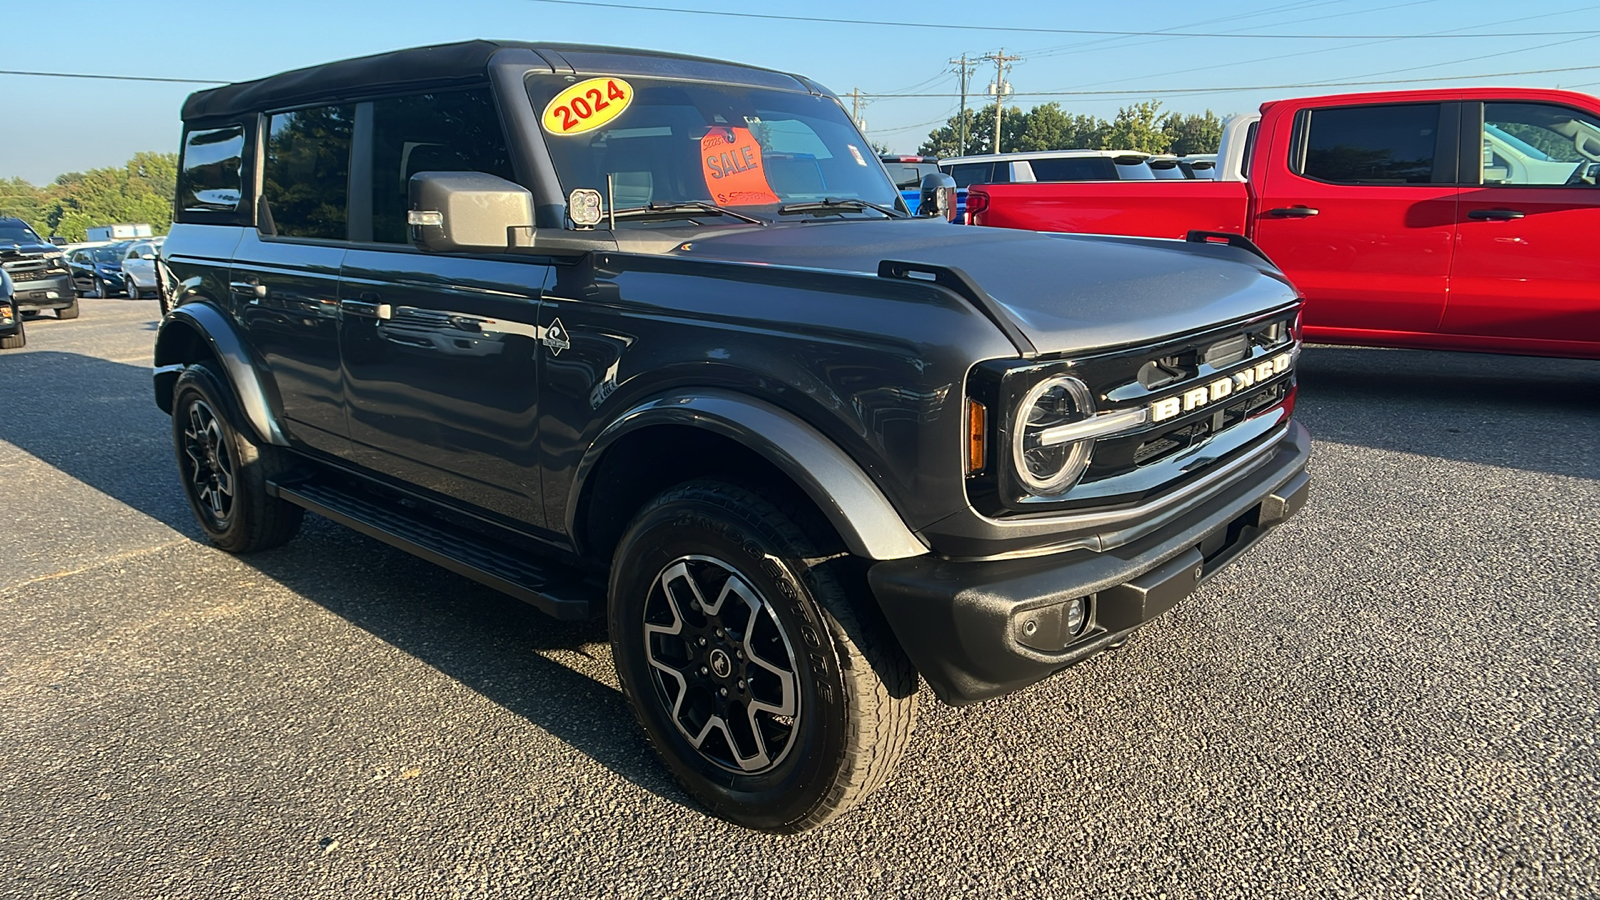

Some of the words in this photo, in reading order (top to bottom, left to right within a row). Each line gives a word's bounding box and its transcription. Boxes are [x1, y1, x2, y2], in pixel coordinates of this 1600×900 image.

[553, 80, 625, 131] 2024
[707, 146, 758, 179] SALE
[1151, 353, 1291, 422] BRONCO
[673, 512, 833, 704] BRIDGESTONE
